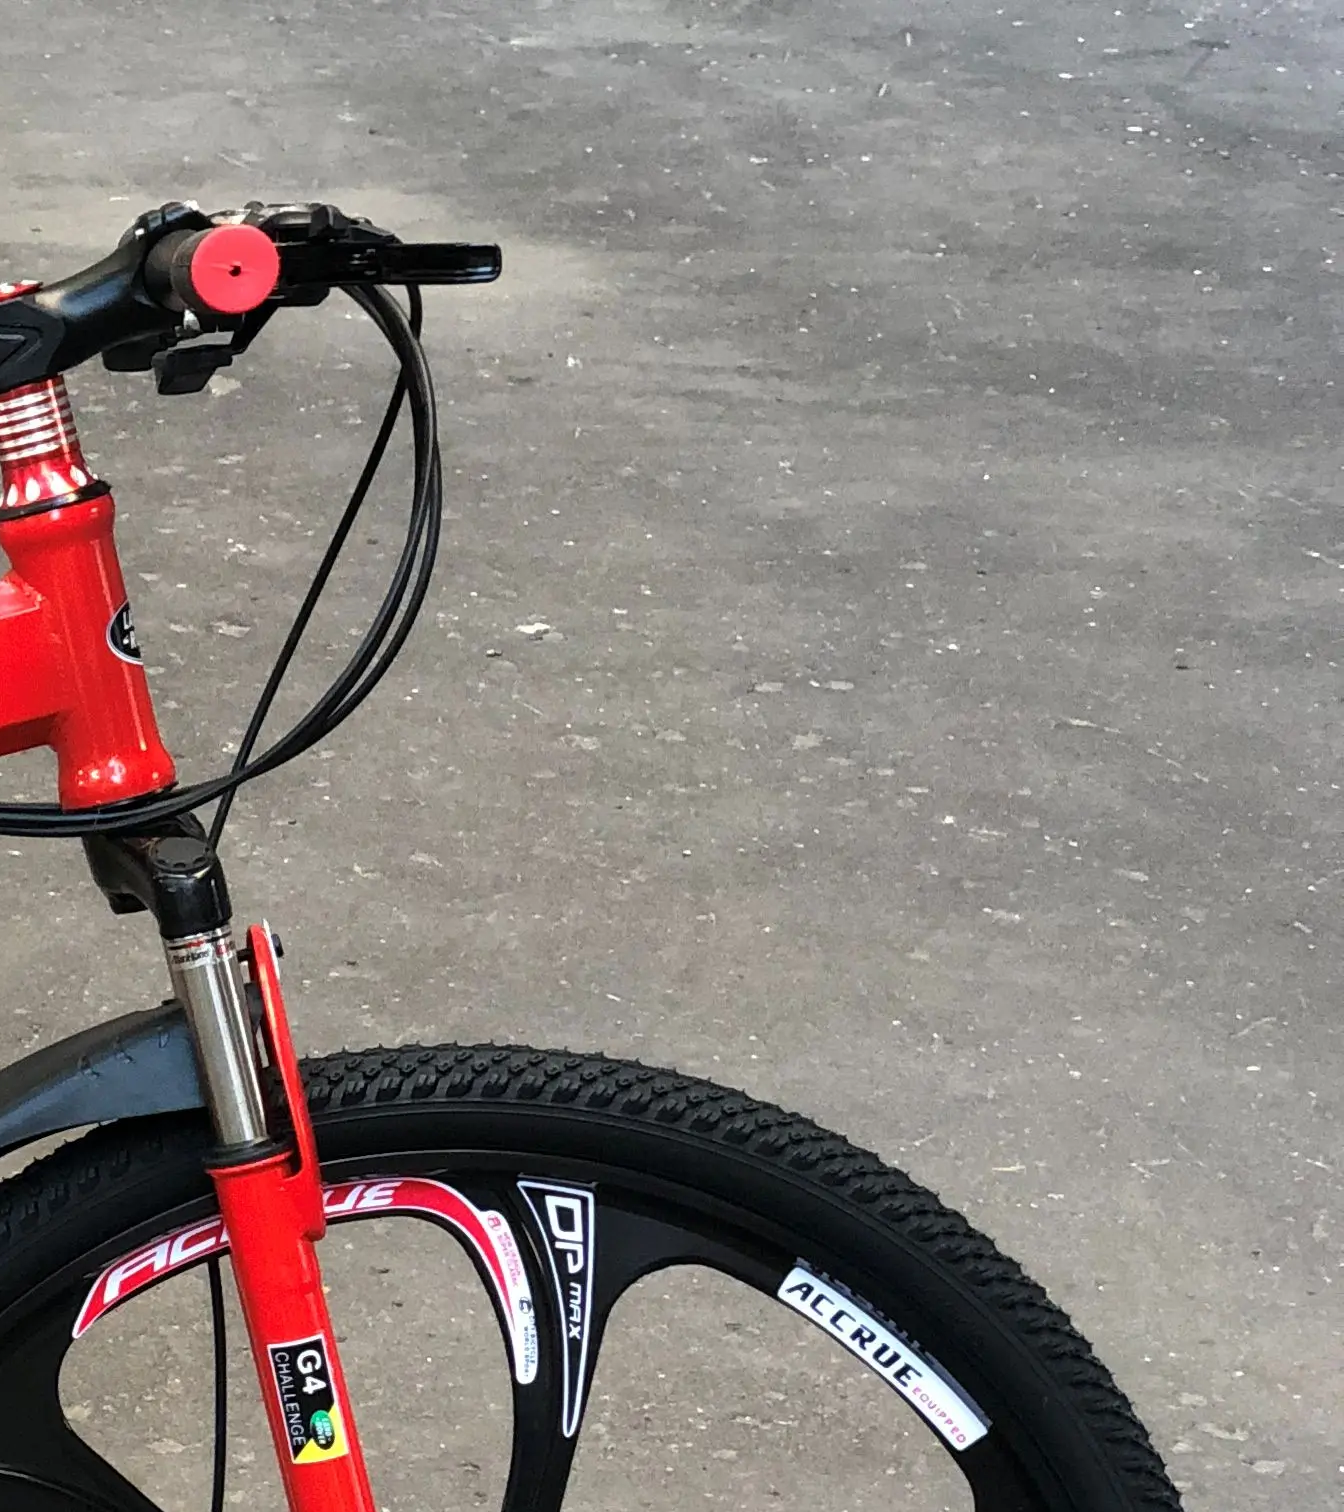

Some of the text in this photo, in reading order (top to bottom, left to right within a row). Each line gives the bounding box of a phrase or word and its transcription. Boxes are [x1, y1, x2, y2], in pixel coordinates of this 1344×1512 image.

[274, 1351, 307, 1446] CHALLENGE
[296, 1349, 327, 1395] G4
[785, 1281, 967, 1444] ACCRUE EQUIPPED
